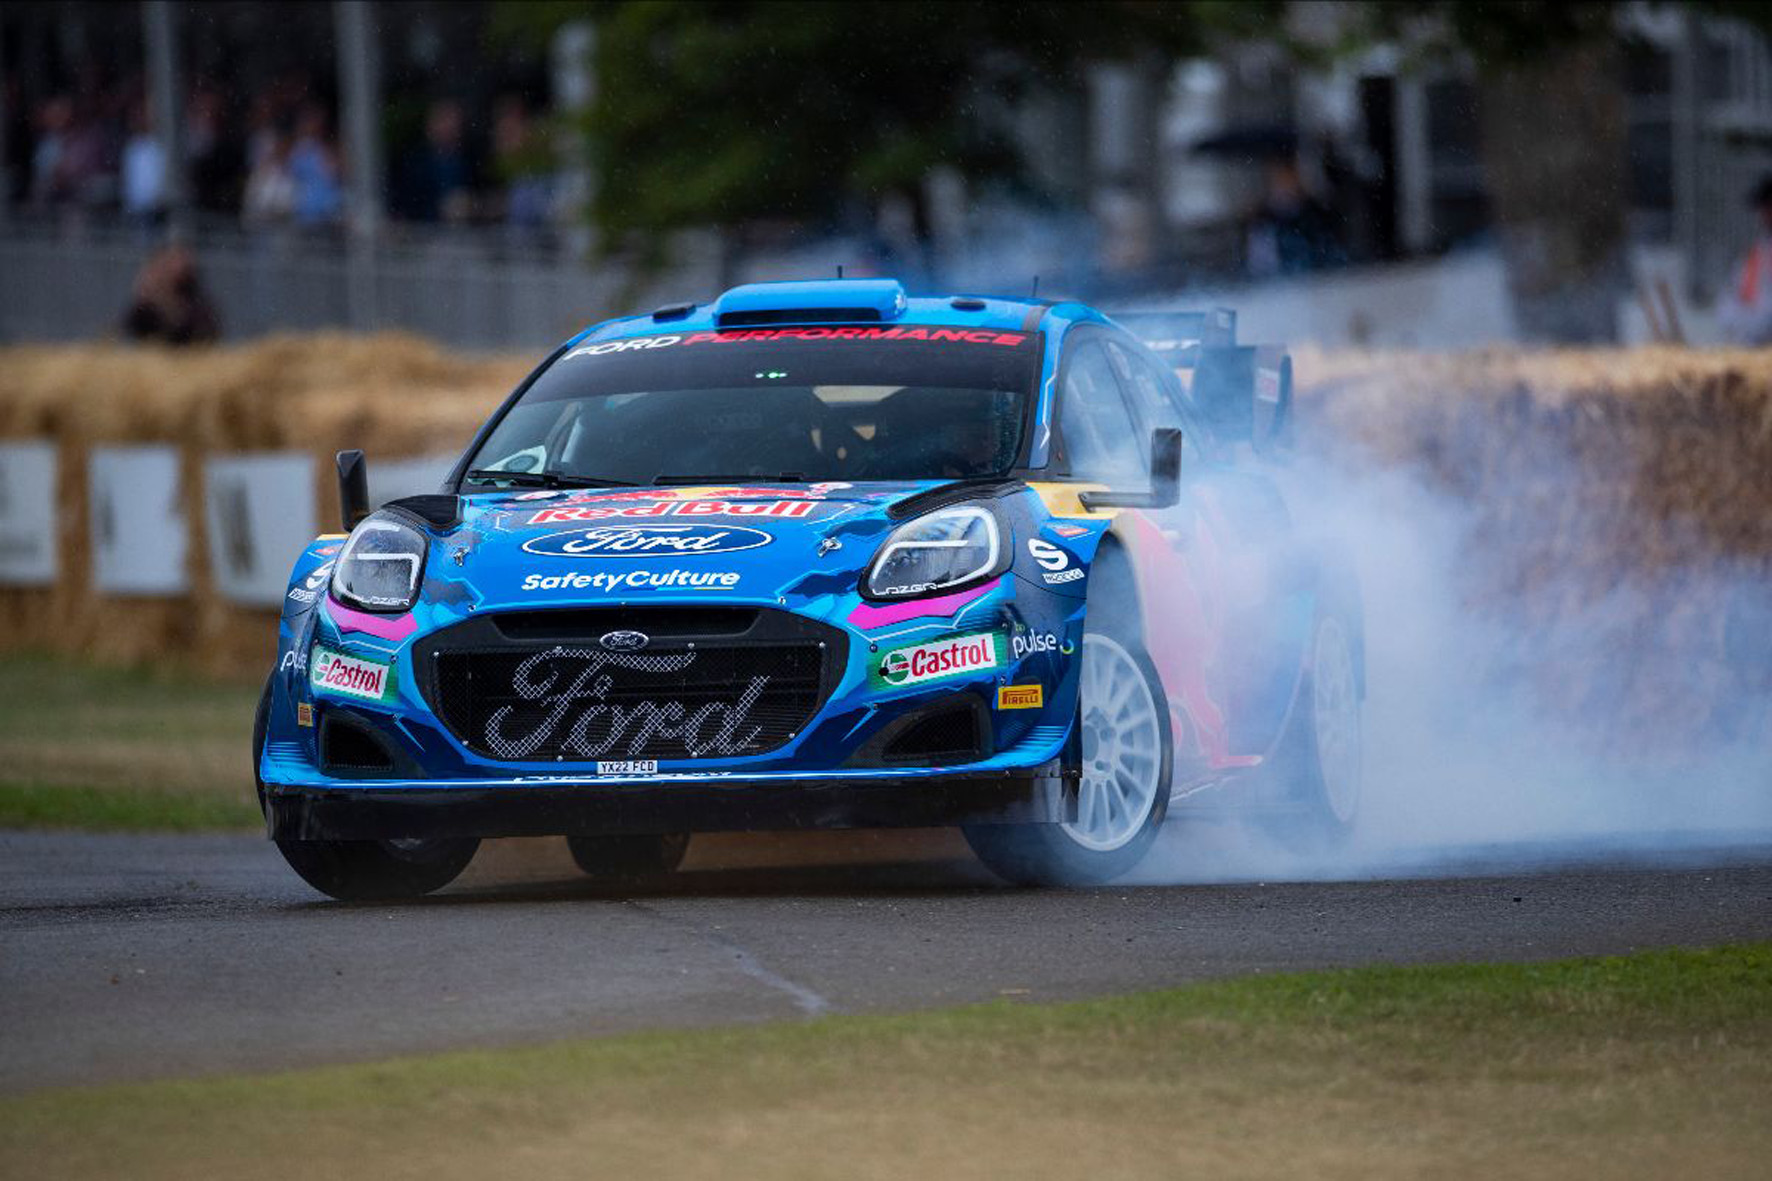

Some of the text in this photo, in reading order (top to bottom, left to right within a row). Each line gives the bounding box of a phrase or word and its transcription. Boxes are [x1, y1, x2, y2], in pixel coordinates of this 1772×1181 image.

[563, 327, 1027, 360] FORD PERFORMANCE
[527, 501, 817, 523] Red Bull
[563, 525, 730, 553] Ford
[522, 569, 740, 592] SafetyCulture
[911, 638, 991, 677] Castrol
[1013, 629, 1057, 658] pulse
[326, 658, 383, 694] Castrol
[485, 650, 771, 758] Ford
[1002, 688, 1039, 705] PIRELLI
[600, 762, 628, 772] YX22
